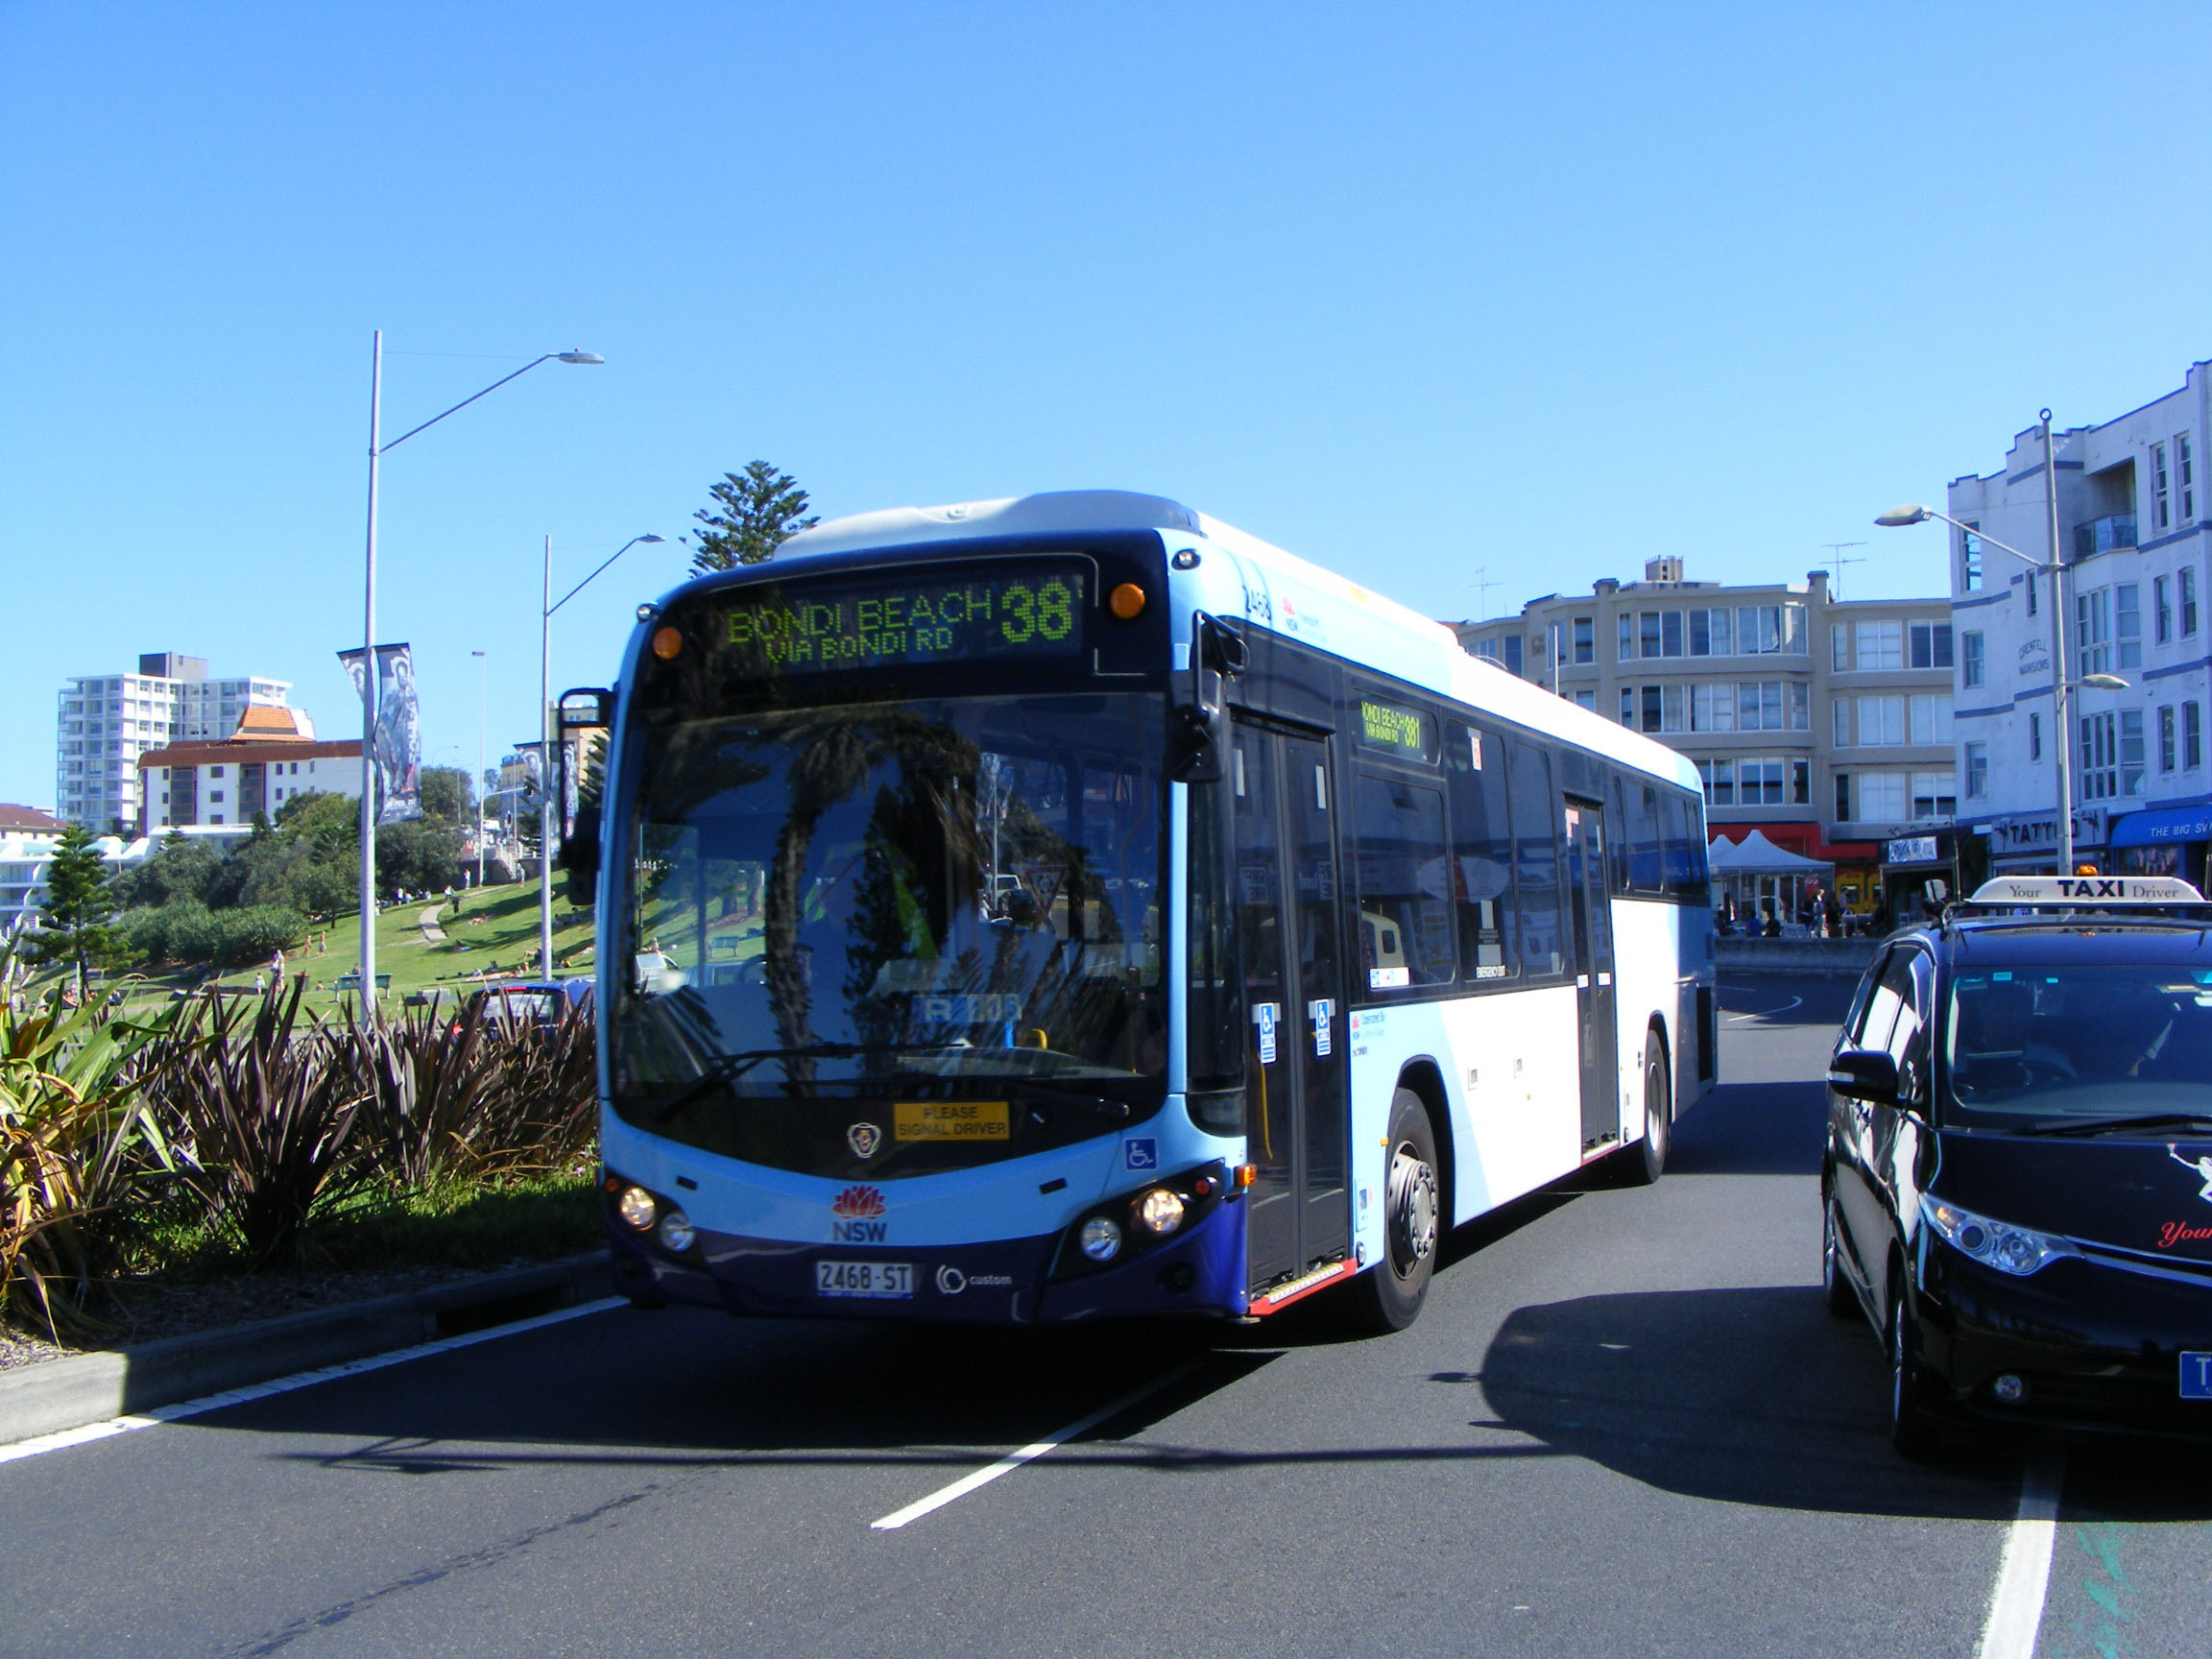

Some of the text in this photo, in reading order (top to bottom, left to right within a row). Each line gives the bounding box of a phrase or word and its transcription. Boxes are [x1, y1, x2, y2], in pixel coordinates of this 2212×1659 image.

[728, 581, 1084, 644] BONDI BEACH 38
[766, 626, 954, 665] VIA BONDI RD
[1405, 713, 1420, 749] 381
[2151, 826, 2170, 838] THE
[2173, 824, 2190, 836] BIG
[2009, 879, 2179, 899] Your TAXI Driver
[923, 1106, 978, 1119] PLEASE
[899, 1121, 1007, 1136] SIGNAL DRIVER
[833, 1221, 887, 1242] NSW
[969, 1275, 1013, 1286] custom
